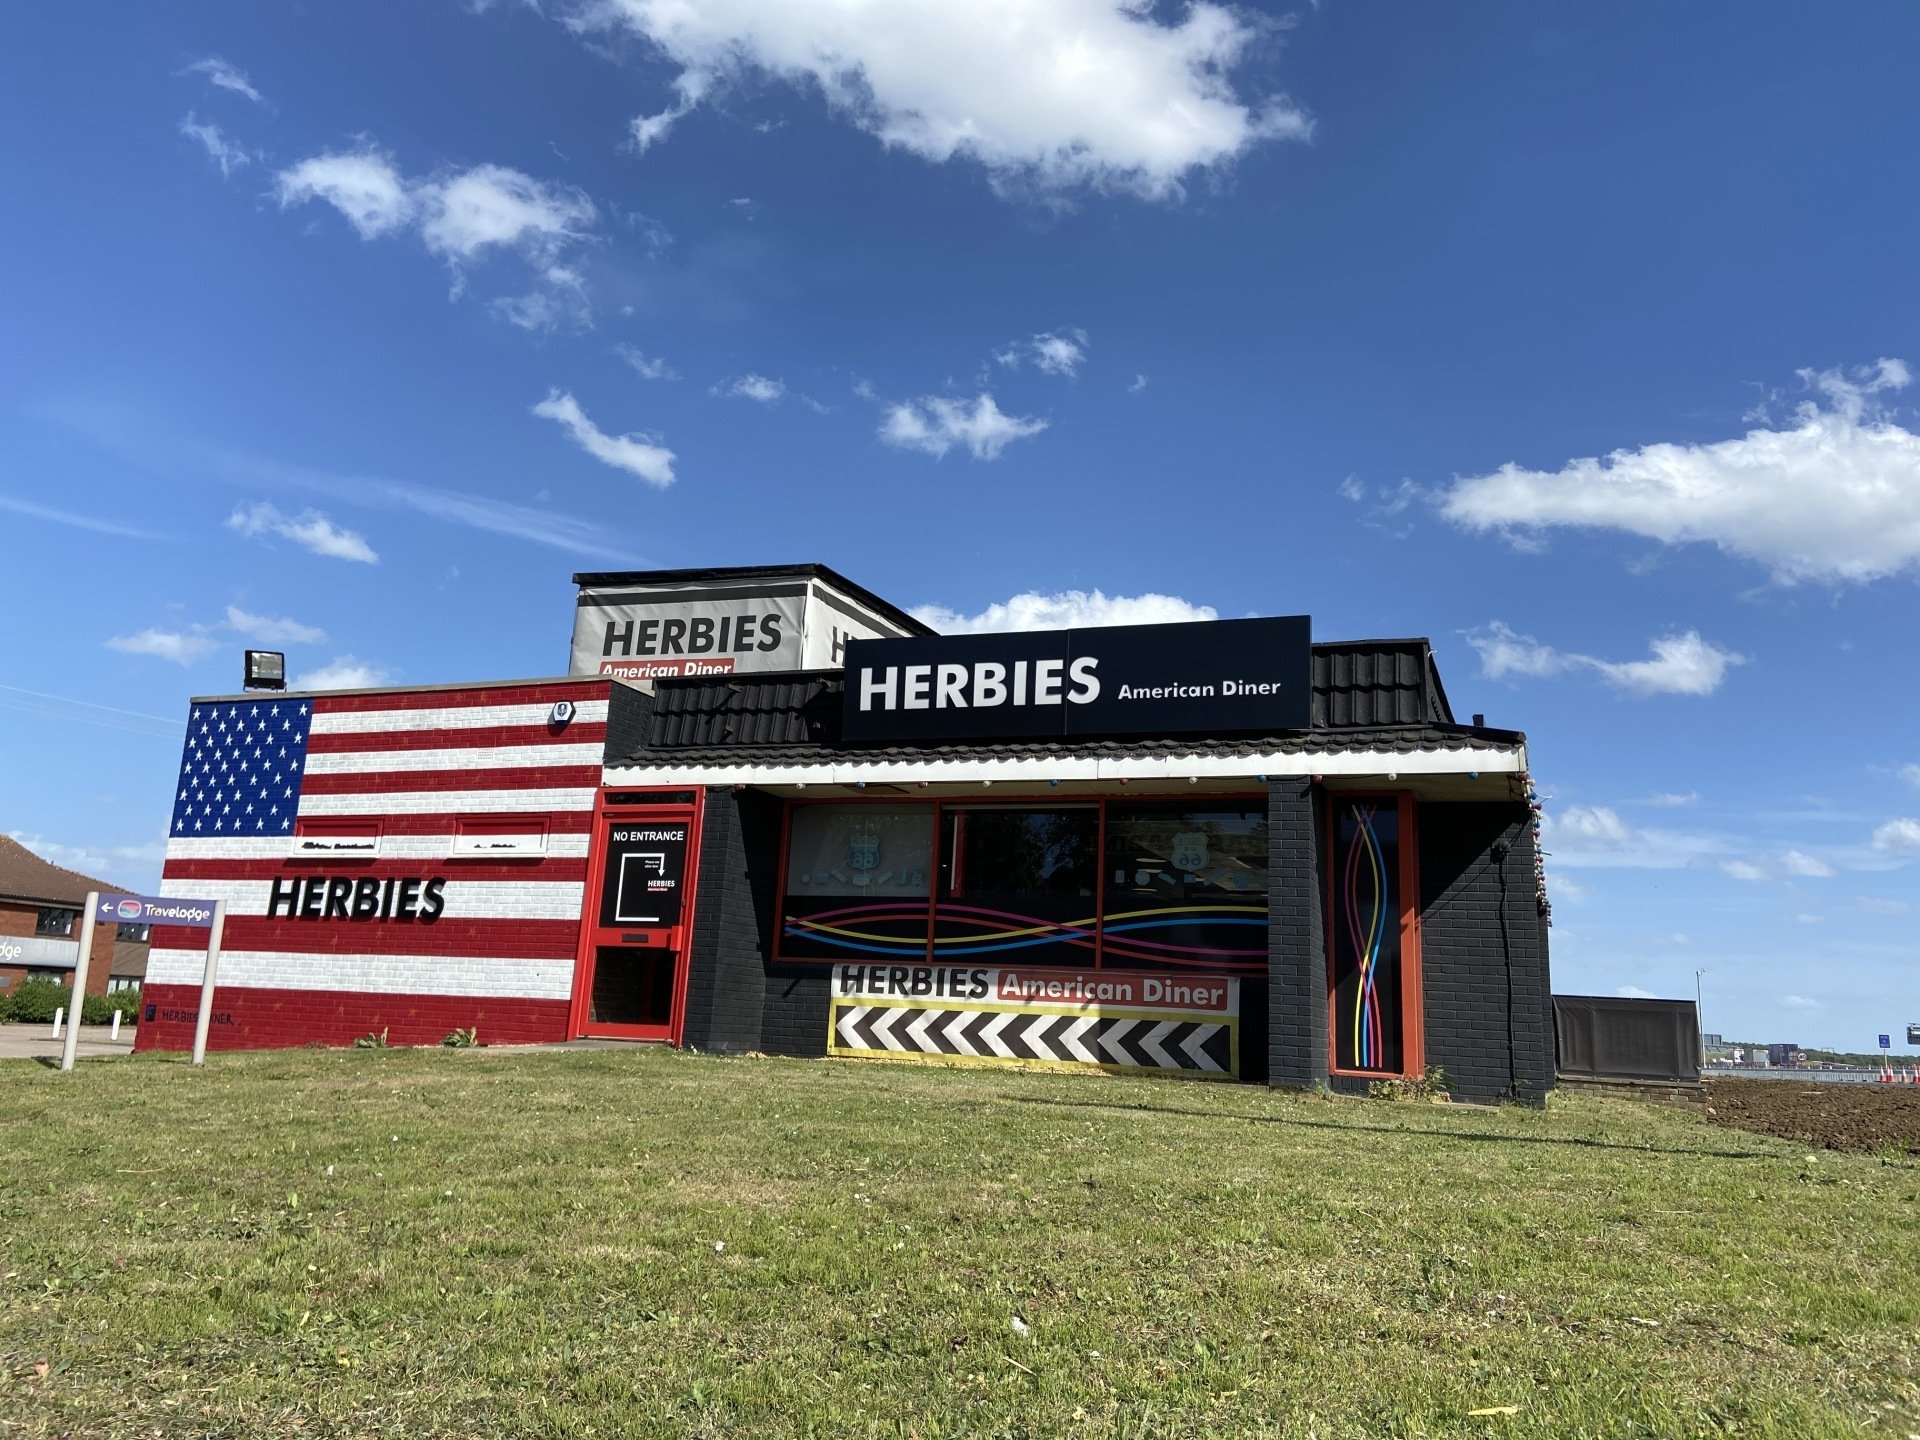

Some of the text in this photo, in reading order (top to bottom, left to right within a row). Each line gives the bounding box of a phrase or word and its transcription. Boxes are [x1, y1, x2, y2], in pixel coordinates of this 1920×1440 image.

[602, 613, 782, 657] HERBIES
[602, 662, 732, 678] American Diner
[860, 656, 1282, 712] HERBIES American Diner
[613, 831, 684, 841] NO ENTRANCE
[144, 904, 210, 922] Travelodge
[266, 876, 447, 925] HERBIES
[839, 965, 1224, 1005] HERBIES American Diner
